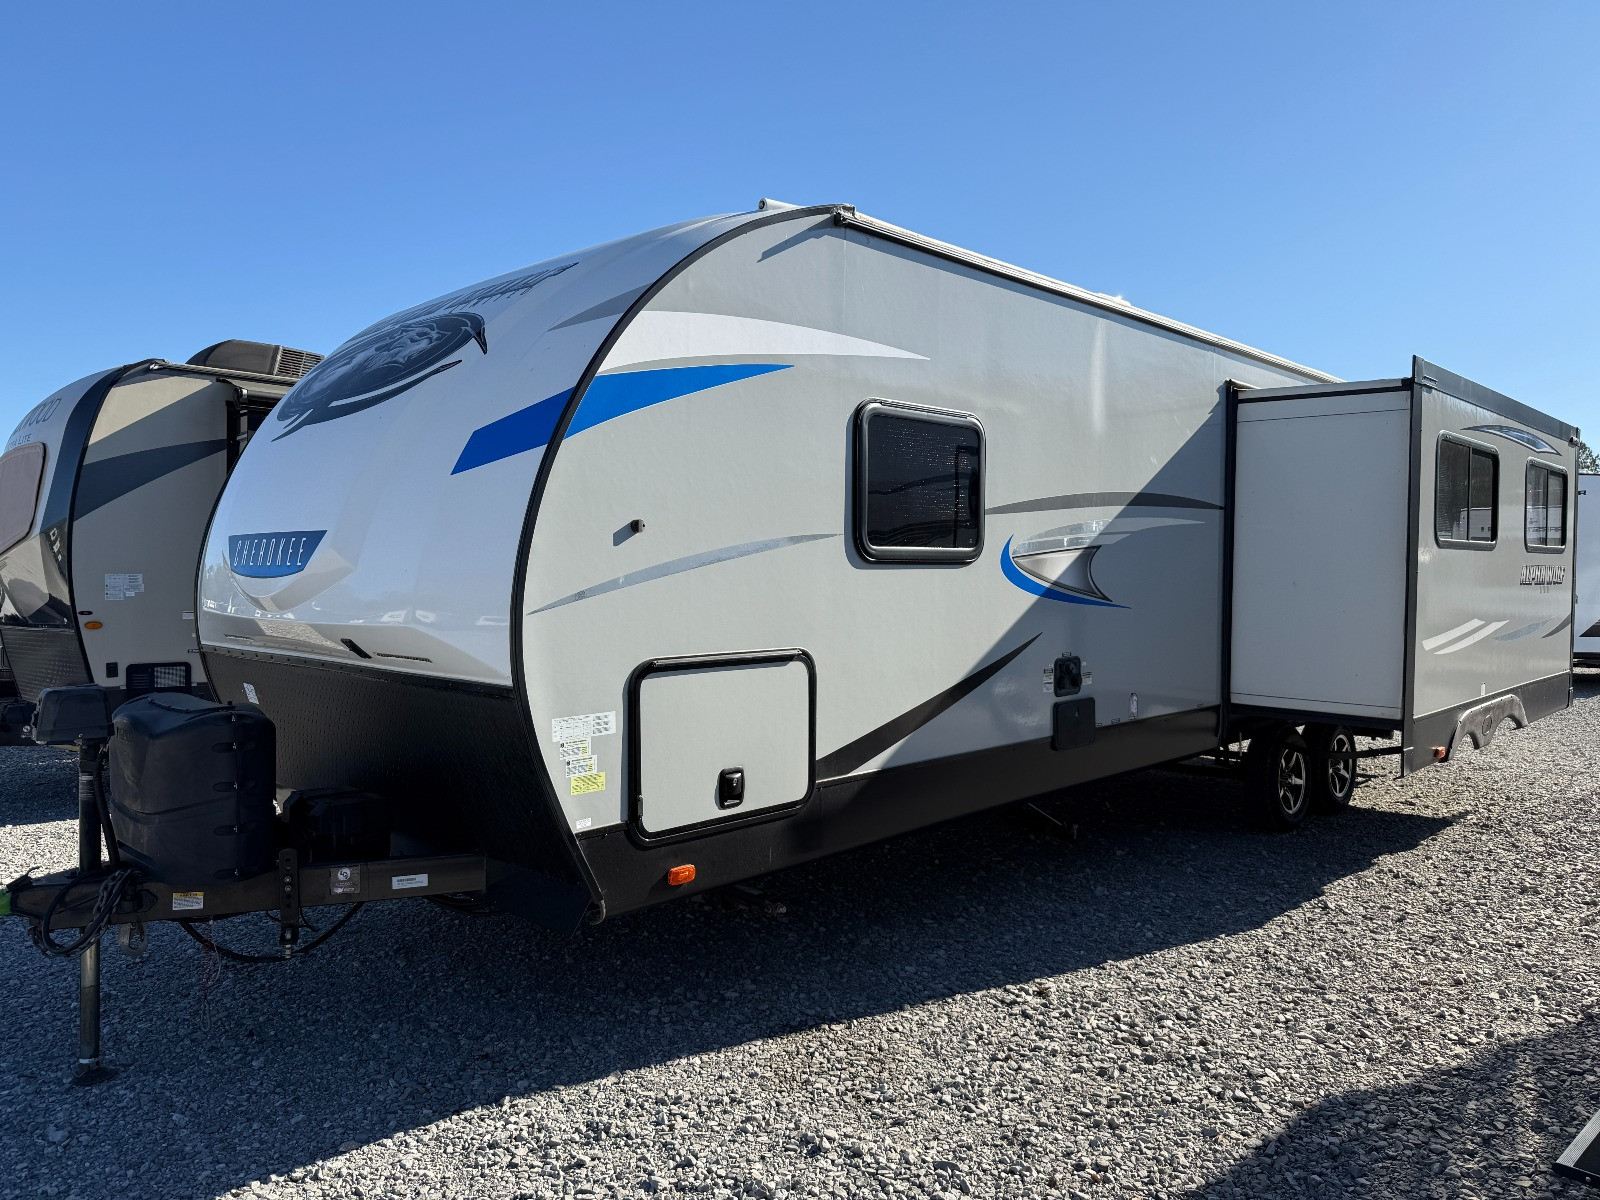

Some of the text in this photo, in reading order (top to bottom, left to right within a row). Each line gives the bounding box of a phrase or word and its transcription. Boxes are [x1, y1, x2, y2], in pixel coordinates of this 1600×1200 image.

[233, 537, 307, 567] CHEROKEE
[1520, 564, 1566, 585] ALPHA WOLF
